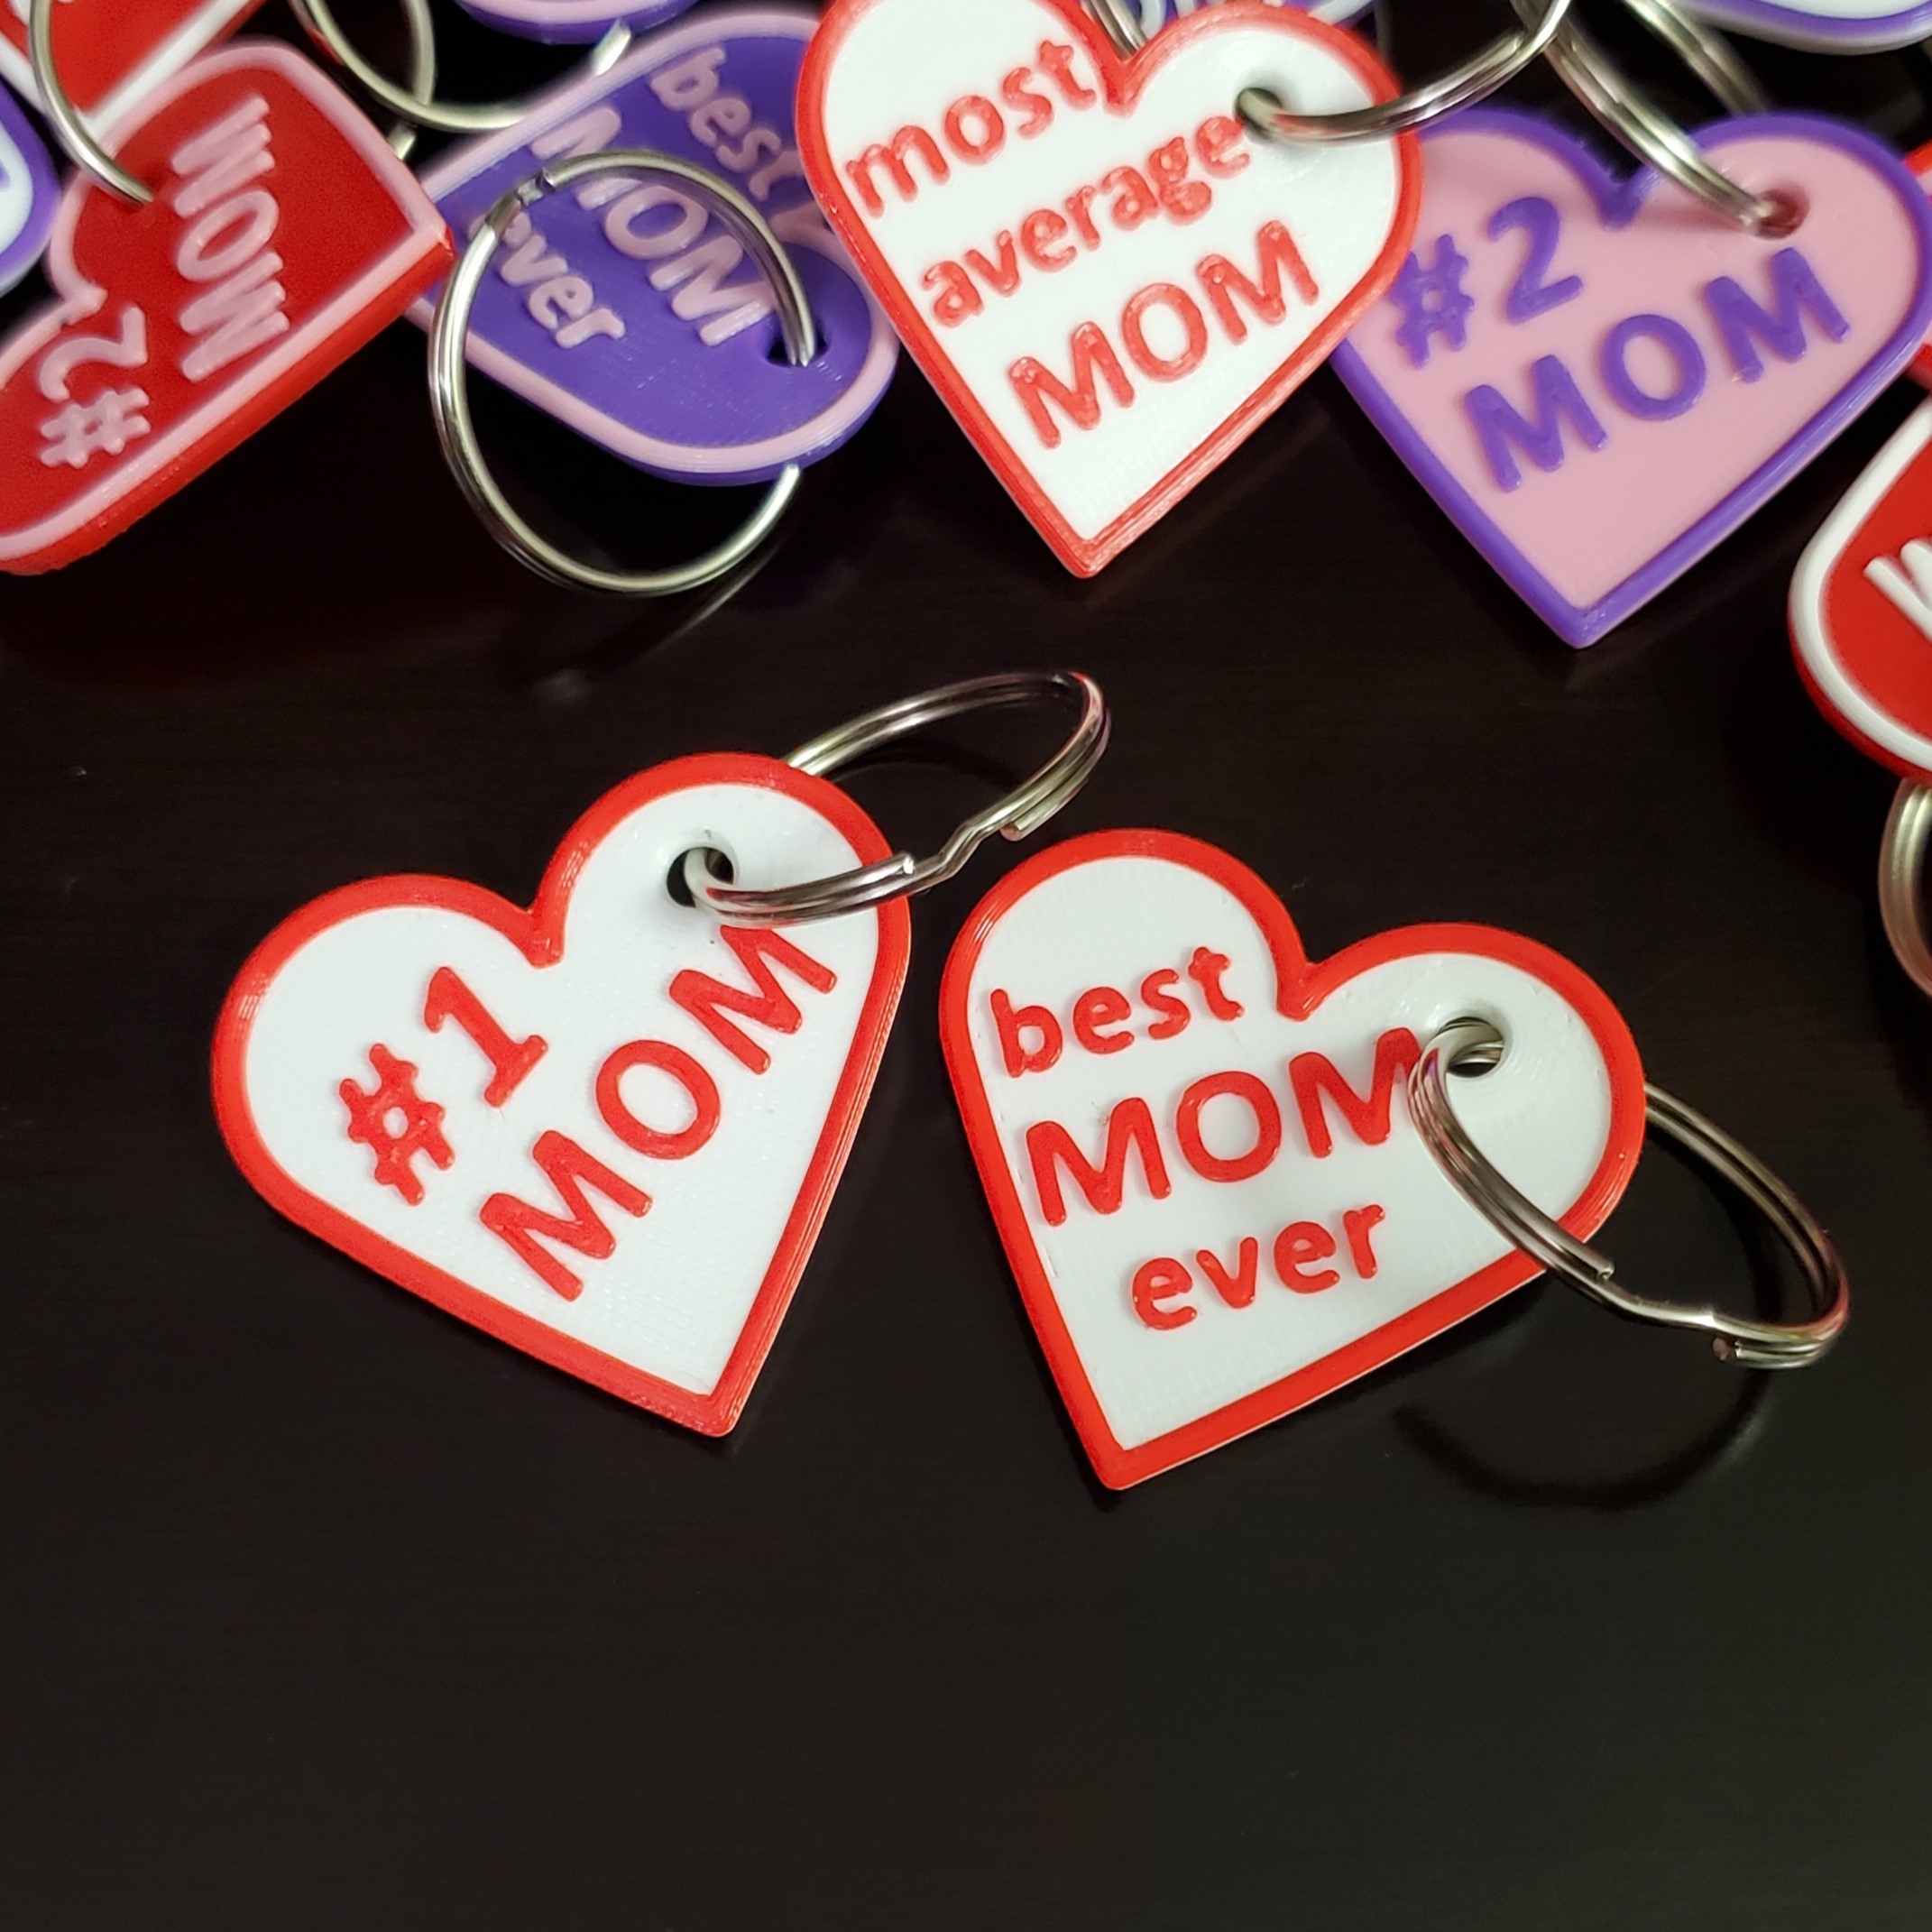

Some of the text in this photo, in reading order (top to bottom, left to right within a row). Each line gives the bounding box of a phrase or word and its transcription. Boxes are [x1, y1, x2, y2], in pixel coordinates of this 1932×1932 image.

[649, 47, 806, 199] best
[846, 40, 1096, 218] most
[920, 115, 1251, 327] average
[170, 96, 290, 382] MOM
[1007, 220, 1320, 449] MOM
[1388, 197, 1584, 369] #2
[39, 303, 150, 468] #2
[1463, 247, 1851, 492] MOM
[338, 966, 548, 1206] #1
[990, 947, 1244, 1078] best
[479, 925, 838, 1302] MOM
[1026, 1026, 1423, 1227] MOM
[1131, 1204, 1385, 1330] ever
